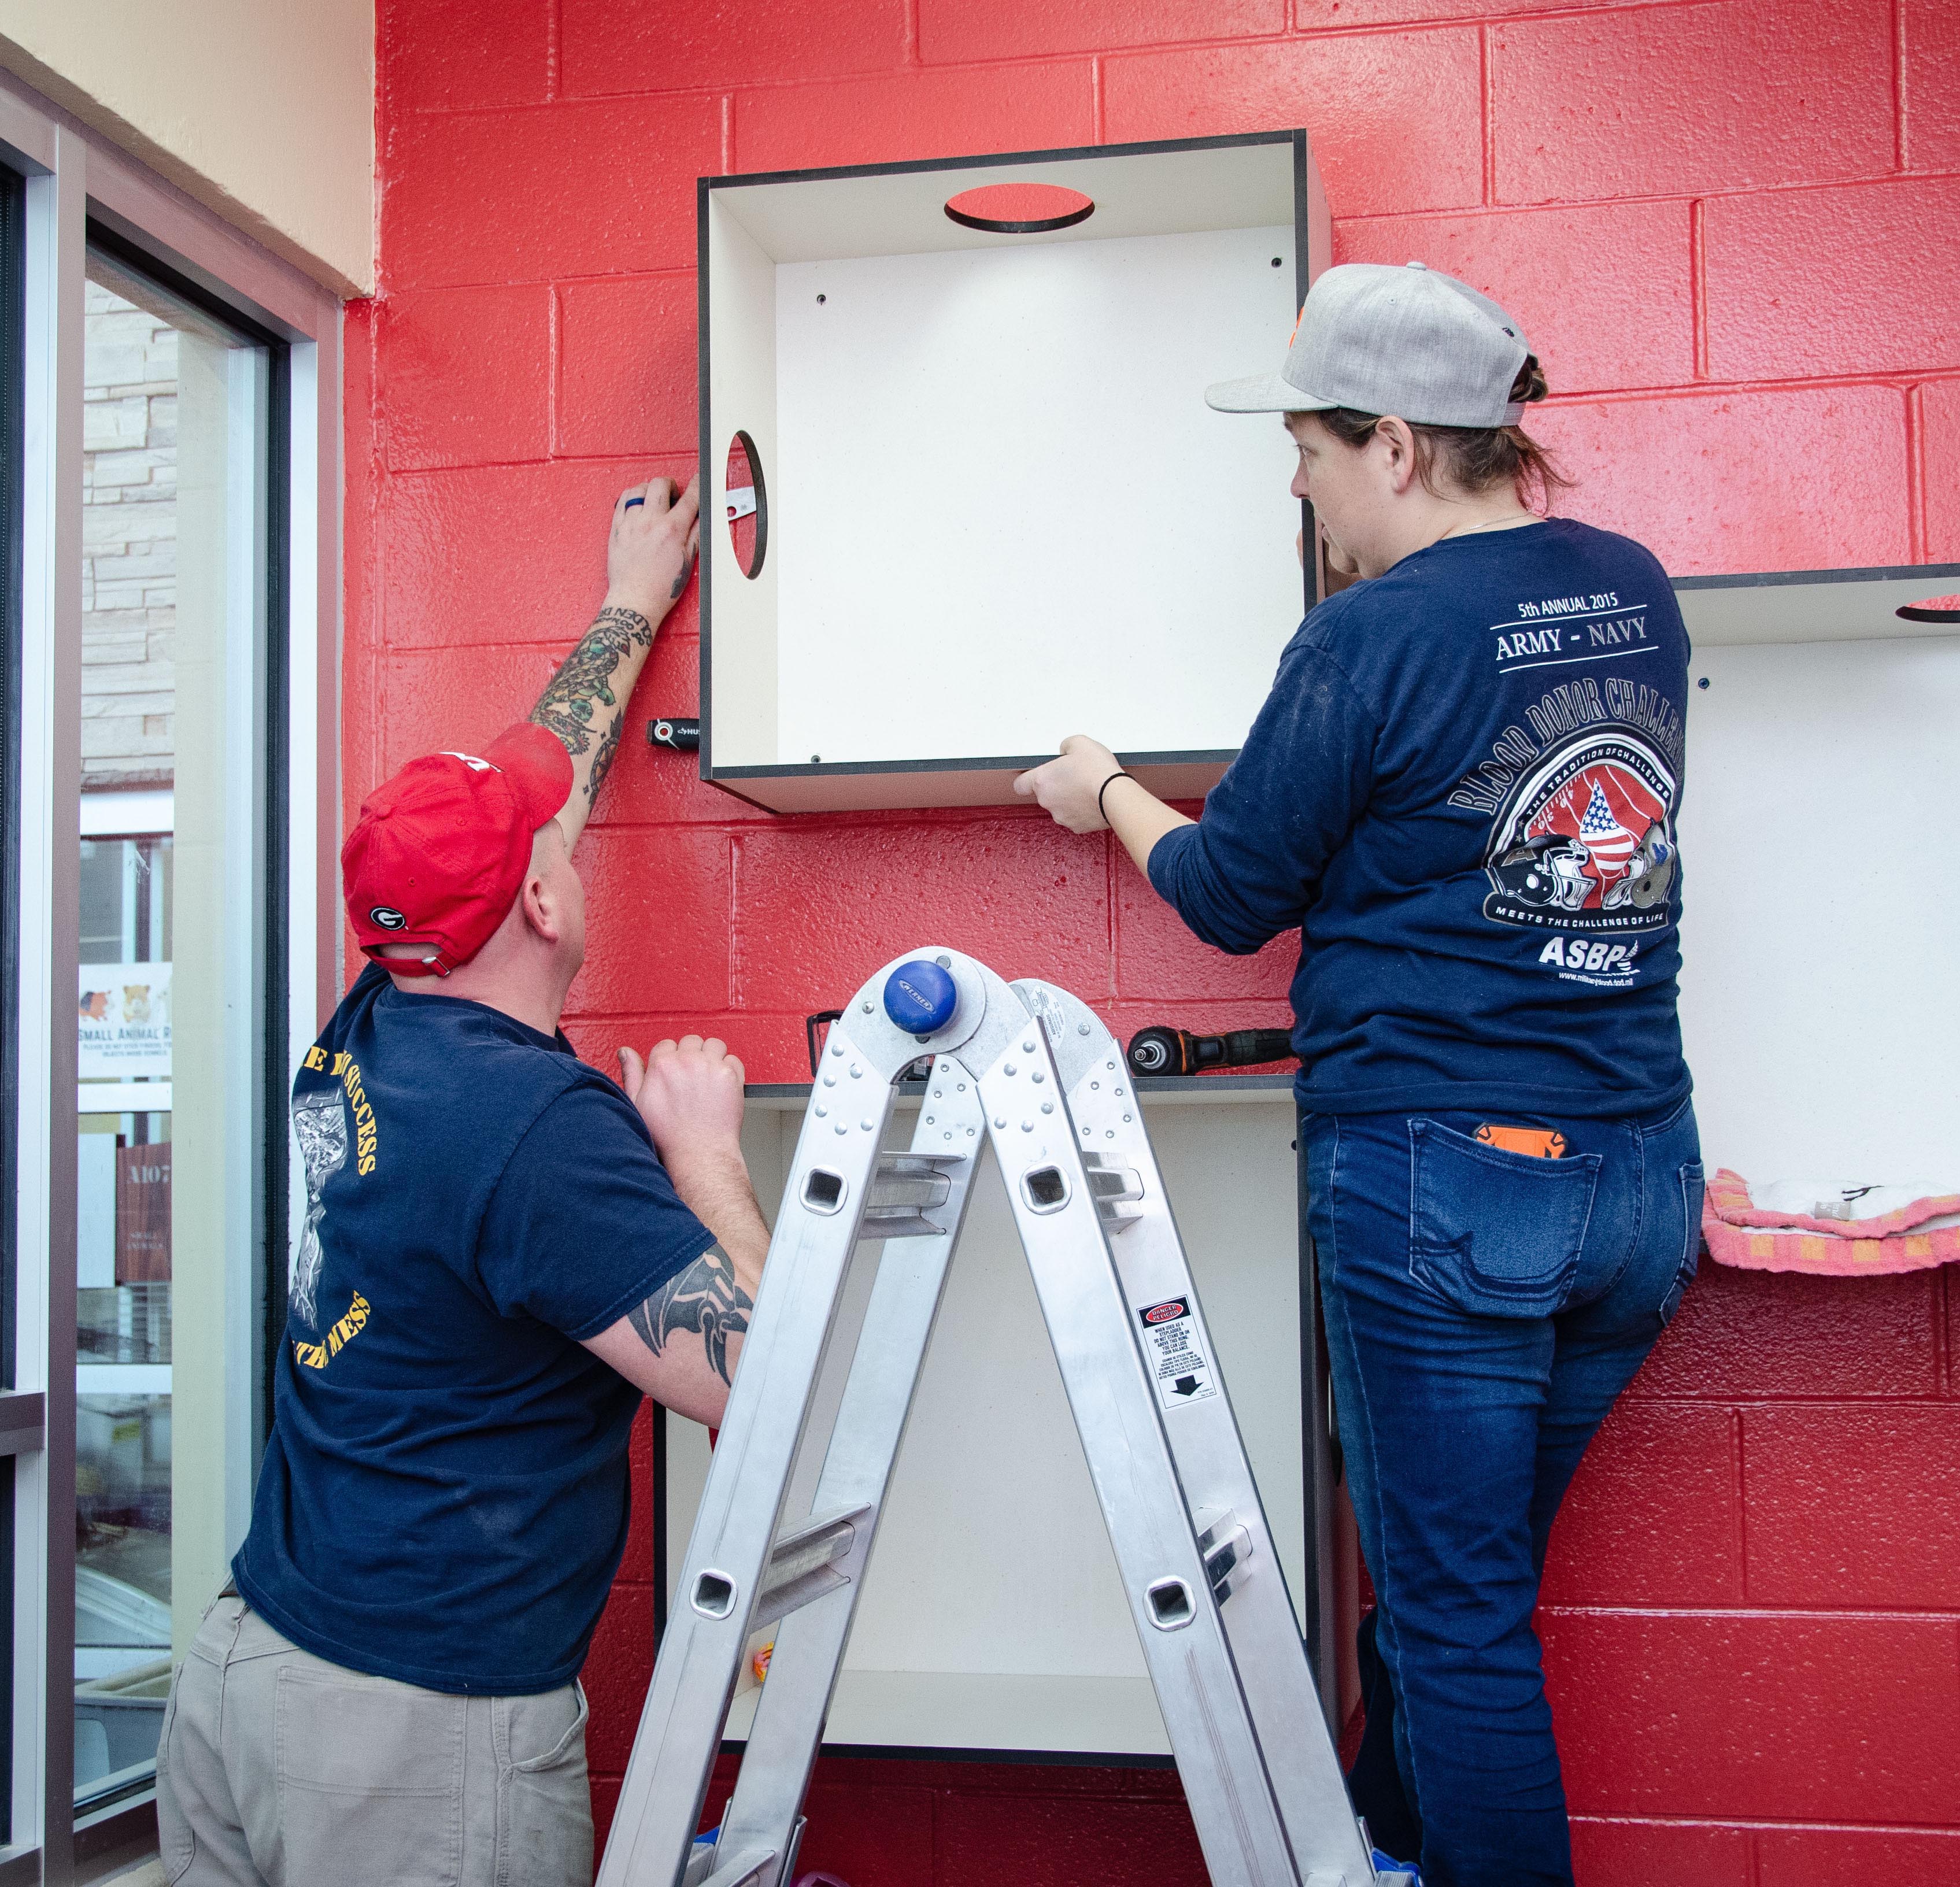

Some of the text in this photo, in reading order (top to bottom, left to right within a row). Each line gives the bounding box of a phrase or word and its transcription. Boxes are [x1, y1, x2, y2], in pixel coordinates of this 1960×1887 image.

[1518, 592, 1618, 617] 5th ANNUAL 2015
[1496, 629, 1561, 660] ARMY
[1587, 616, 1647, 646] NAVY
[1447, 726, 1539, 816] BLOOD
[1525, 678, 1607, 748] DONOR
[1526, 792, 1547, 815] THE
[1548, 749, 1603, 790] TRADITION
[1618, 748, 1670, 799] CHALLENGE
[1496, 906, 1664, 928] MEETS THE CHALLENGE OF LIFE
[1539, 937, 1626, 972] ASBP
[79, 1028, 112, 1041] SMALL
[118, 1028, 158, 1040] ANIMAL
[344, 1064, 377, 1176] SUCCESS
[328, 1290, 371, 1357] MESS
[1152, 1305, 1177, 1316] DANGER
[1153, 1309, 1179, 1321] PELIGRO
[1159, 1327, 1181, 1337] STEPLADDER
